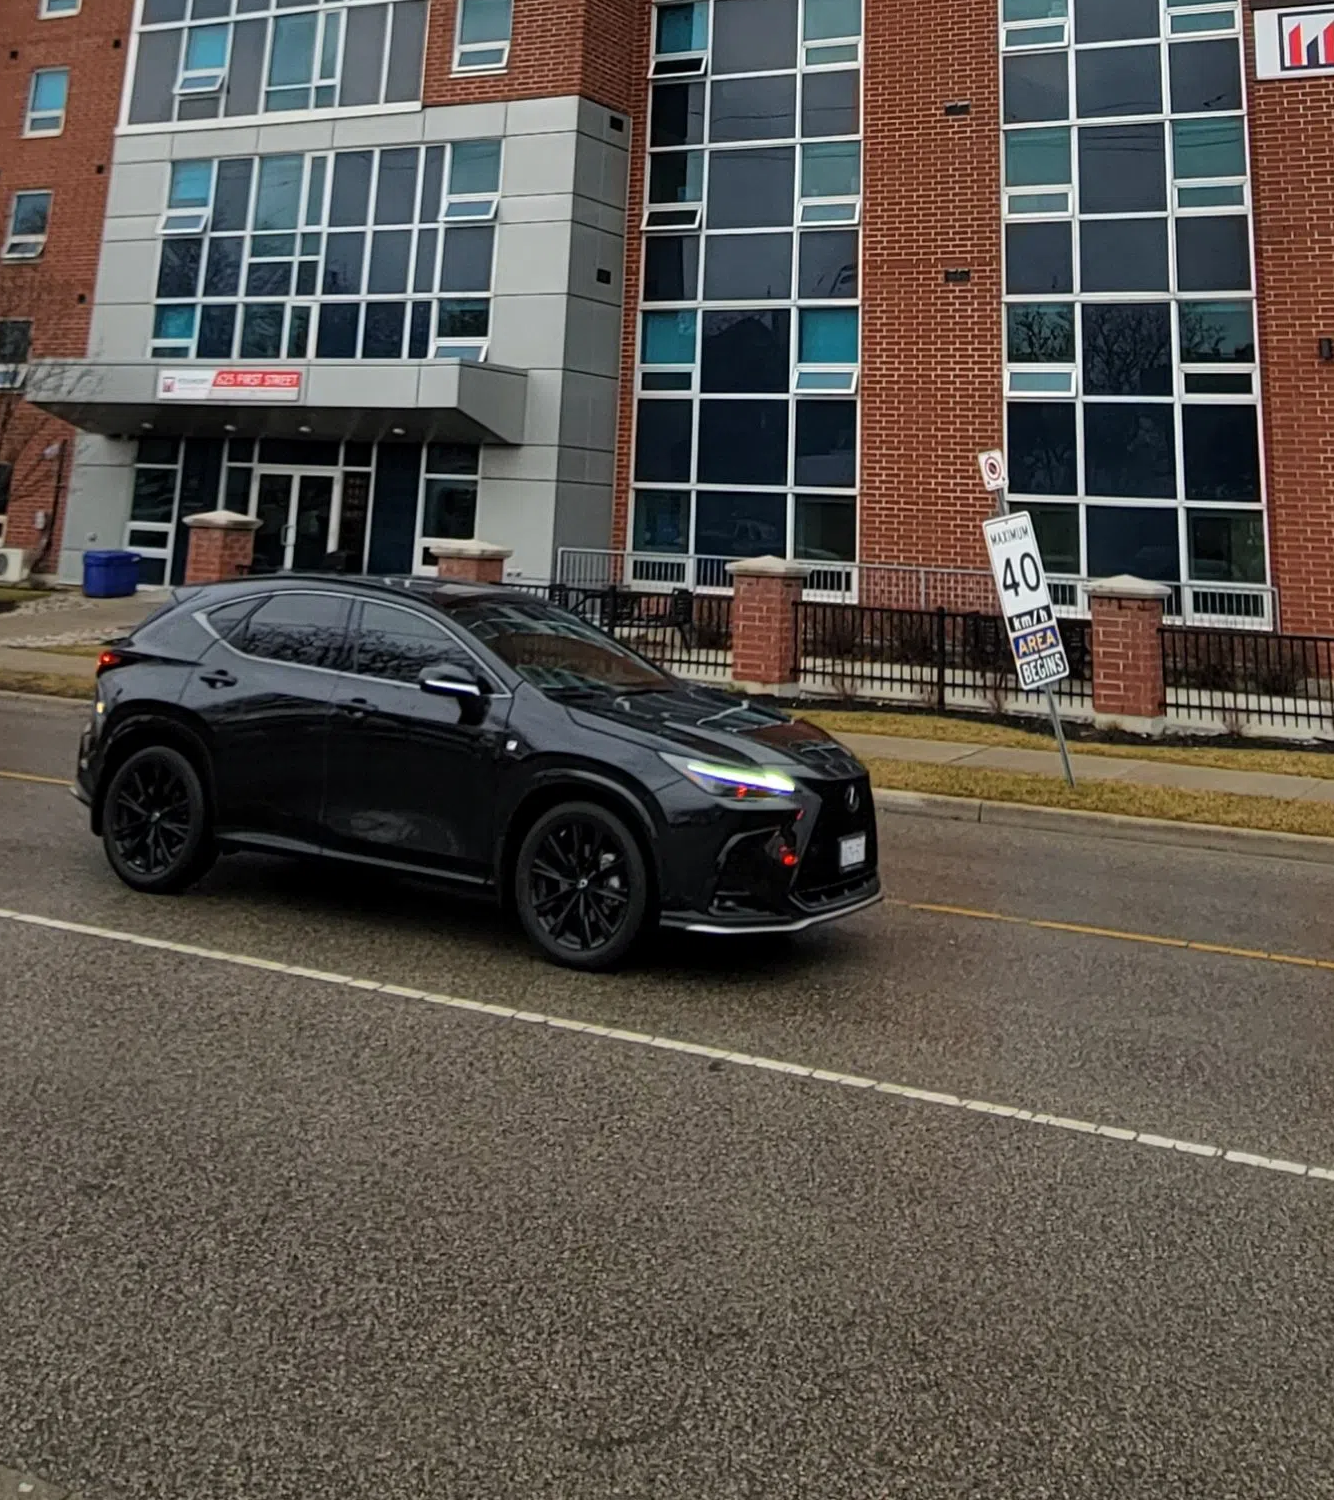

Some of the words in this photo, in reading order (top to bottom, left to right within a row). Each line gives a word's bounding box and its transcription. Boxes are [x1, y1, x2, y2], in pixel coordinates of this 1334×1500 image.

[236, 373, 263, 385] FIRST
[264, 374, 299, 386] STREET
[990, 525, 1030, 547] MAXIMUM
[1002, 552, 1041, 597] 40
[1012, 609, 1049, 631] km/h
[1018, 629, 1057, 658] AREA
[1022, 653, 1064, 685] BEGINS
